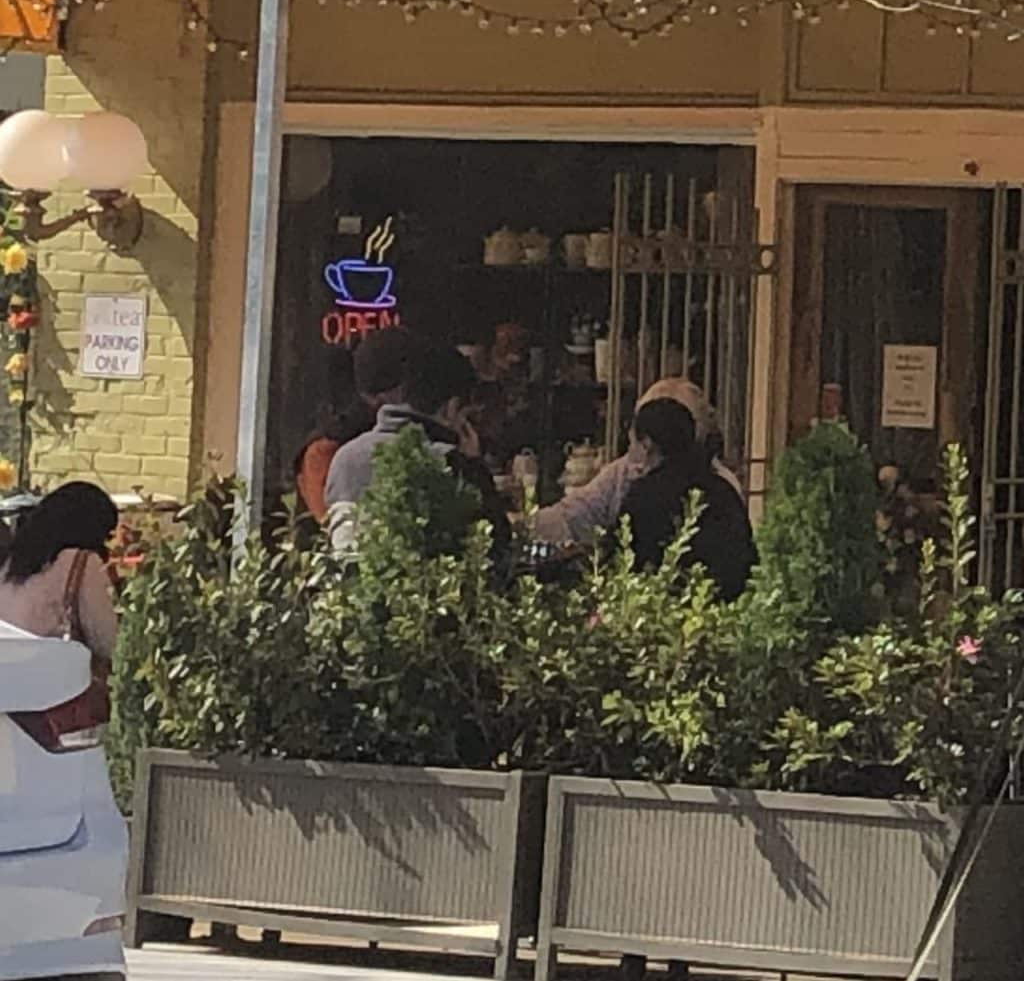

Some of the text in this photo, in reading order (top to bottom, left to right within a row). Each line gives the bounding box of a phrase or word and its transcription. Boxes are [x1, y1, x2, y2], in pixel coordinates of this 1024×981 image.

[322, 311, 400, 348] OPEN
[84, 334, 140, 352] PARKING
[95, 355, 129, 372] ONLY
